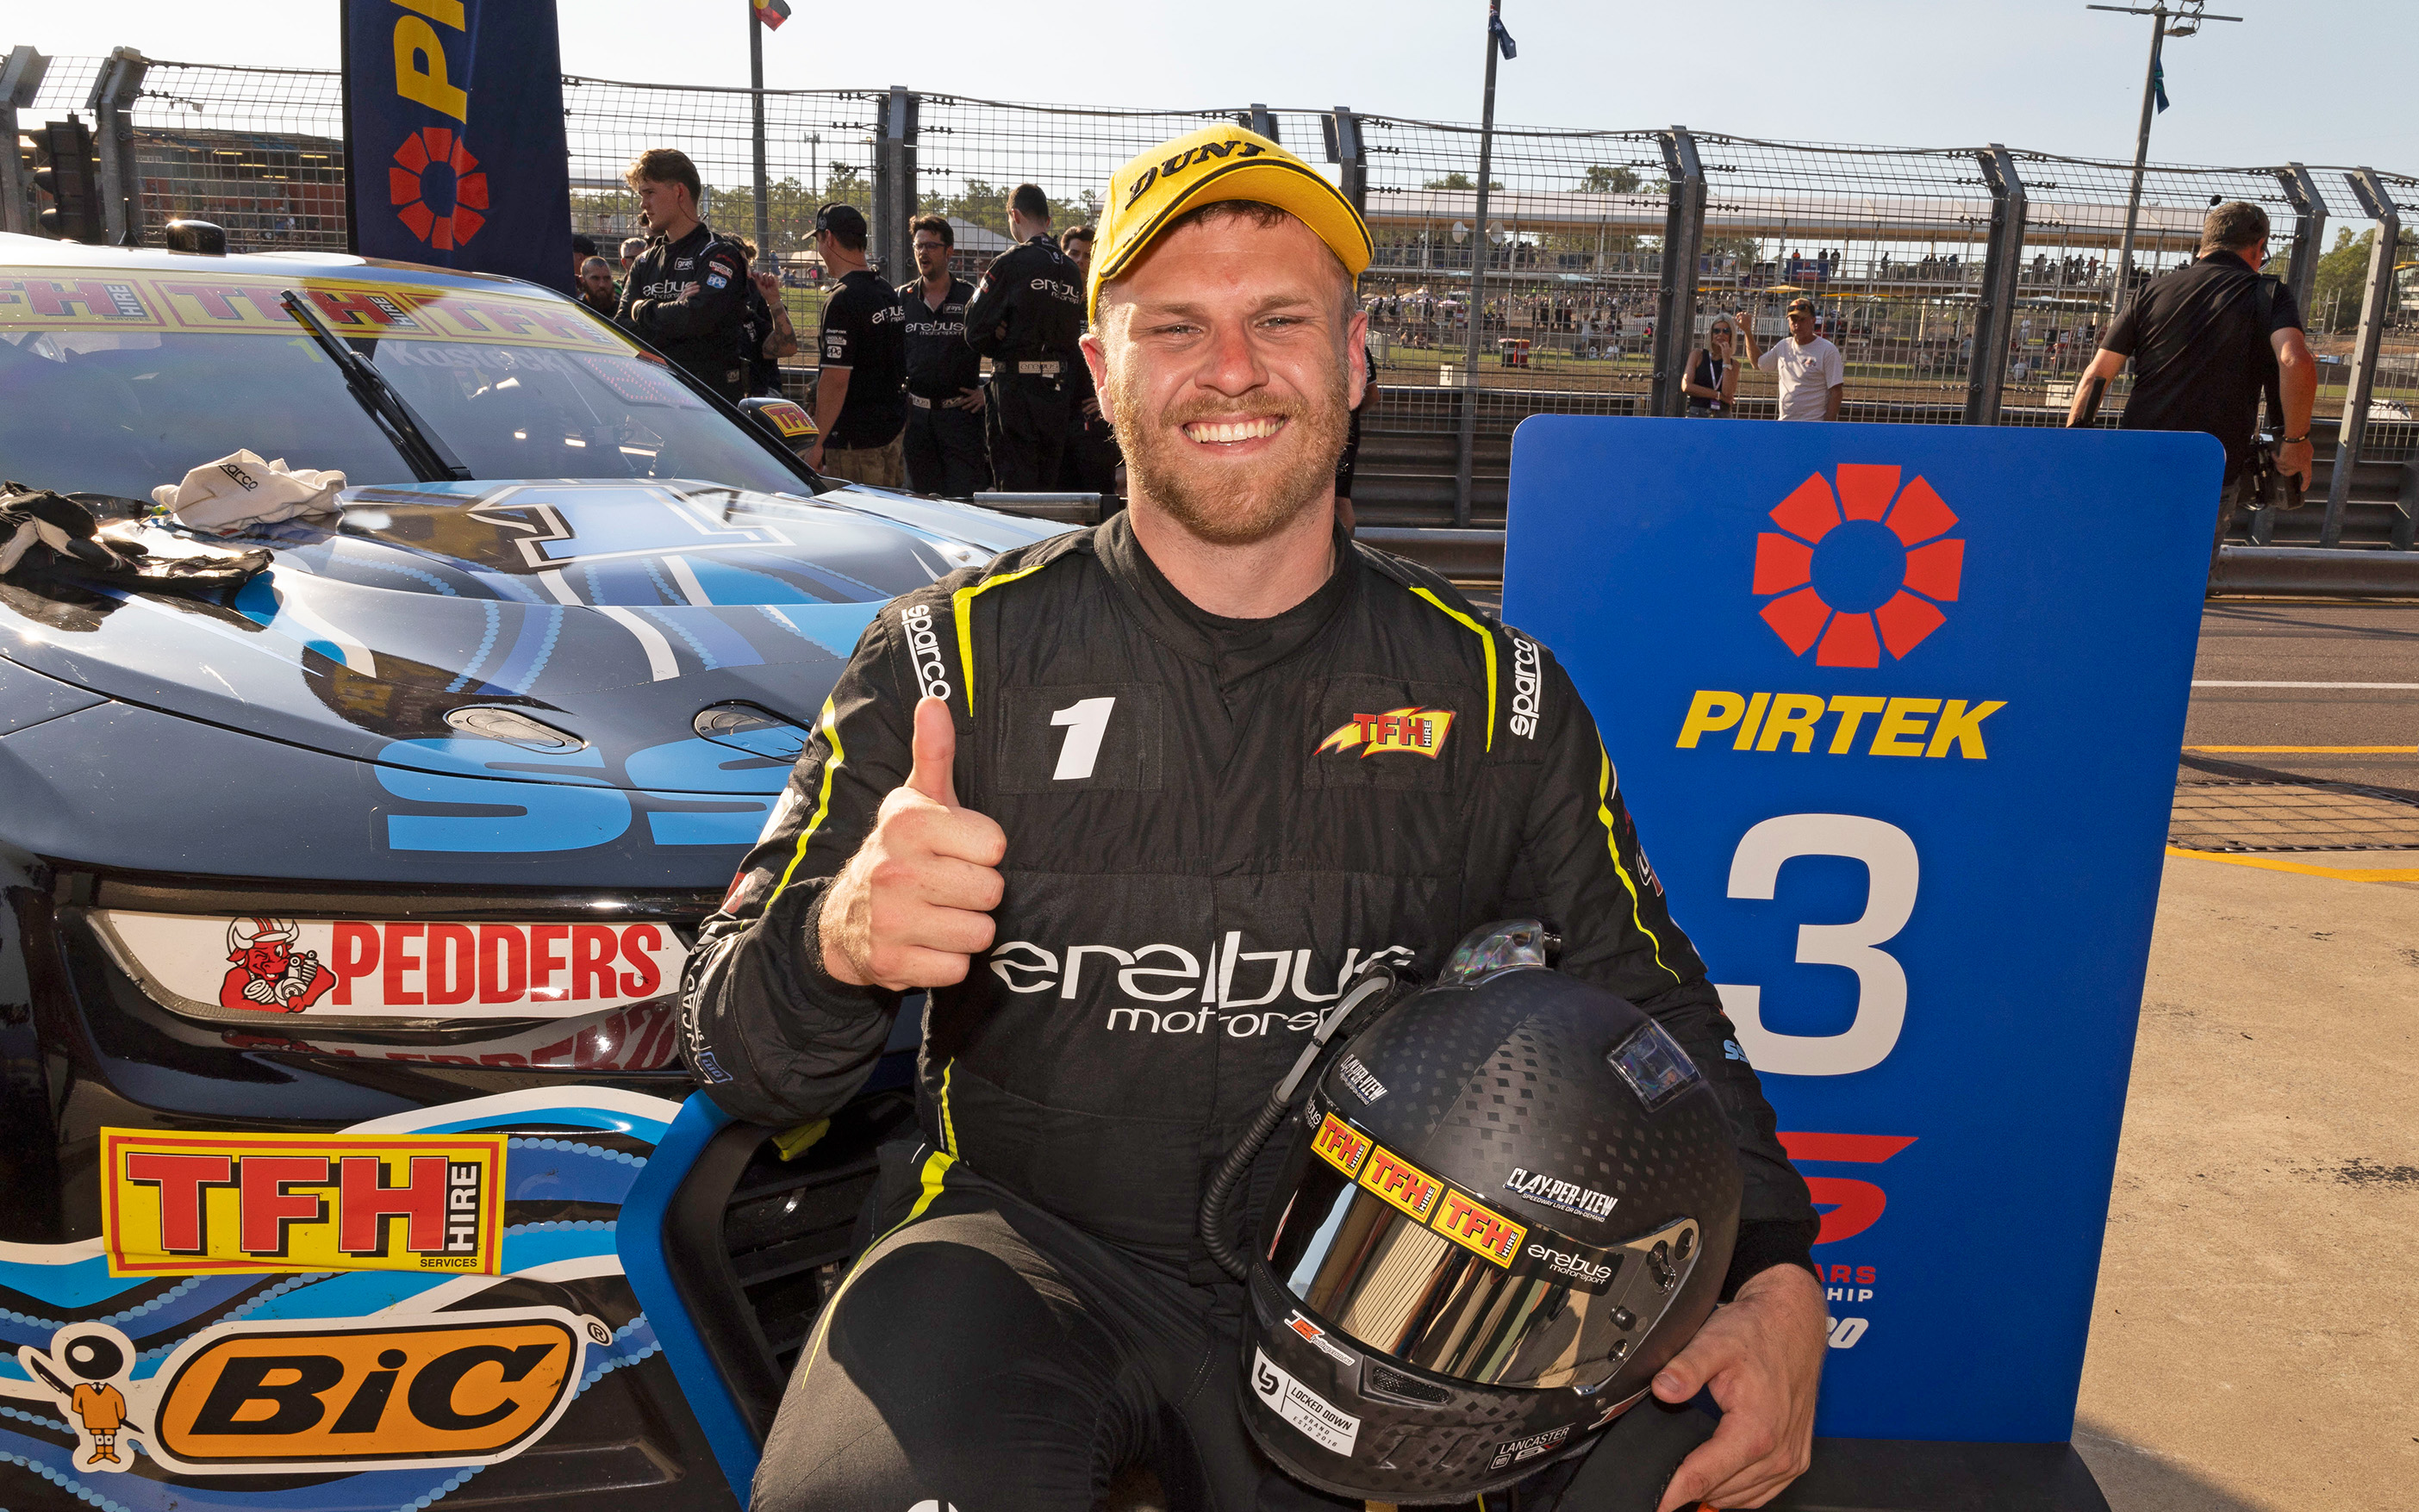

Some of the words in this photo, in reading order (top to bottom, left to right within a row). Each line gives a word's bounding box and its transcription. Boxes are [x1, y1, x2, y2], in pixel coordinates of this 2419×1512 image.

[103, 284, 147, 317] HIRE
[370, 296, 416, 327] HIRE
[410, 296, 598, 344] TFH
[906, 320, 964, 333] erebus
[827, 346, 842, 358] PPG
[766, 406, 814, 429] TFH
[901, 605, 951, 701] sparco
[1510, 638, 1541, 740] sparco
[1050, 697, 1116, 781] 1
[1353, 713, 1426, 748] TFH
[1424, 720, 1432, 747] HIRE
[1675, 690, 2008, 760] PIRTEK
[332, 921, 662, 1006] PEDDERS
[1713, 812, 1920, 1076] 3
[1319, 1119, 1362, 1165] TFH
[1350, 1145, 1365, 1168] HIRE
[1371, 1153, 1431, 1209] TFH
[1418, 1187, 1436, 1212] HIRE
[1506, 1167, 1619, 1217] CLAY-PER-VIEW
[126, 1152, 450, 1257] TFH
[448, 1165, 477, 1251] HIRE
[1522, 1192, 1553, 1207] SPEEDWAY
[1574, 1209, 1605, 1223] ON-DEMAND
[1446, 1197, 1514, 1255] TFH
[1500, 1232, 1519, 1258] HIRE
[420, 1257, 478, 1268] SERVICES
[1528, 1243, 1612, 1279] erebus
[1549, 1263, 1607, 1285] motorsport
[1291, 1386, 1324, 1414] LOCKED
[1322, 1409, 1352, 1431] DOWN
[1293, 1416, 1312, 1432] ESTD
[1303, 1415, 1330, 1435] BRAND
[1499, 1427, 1570, 1455] LANCASTER
